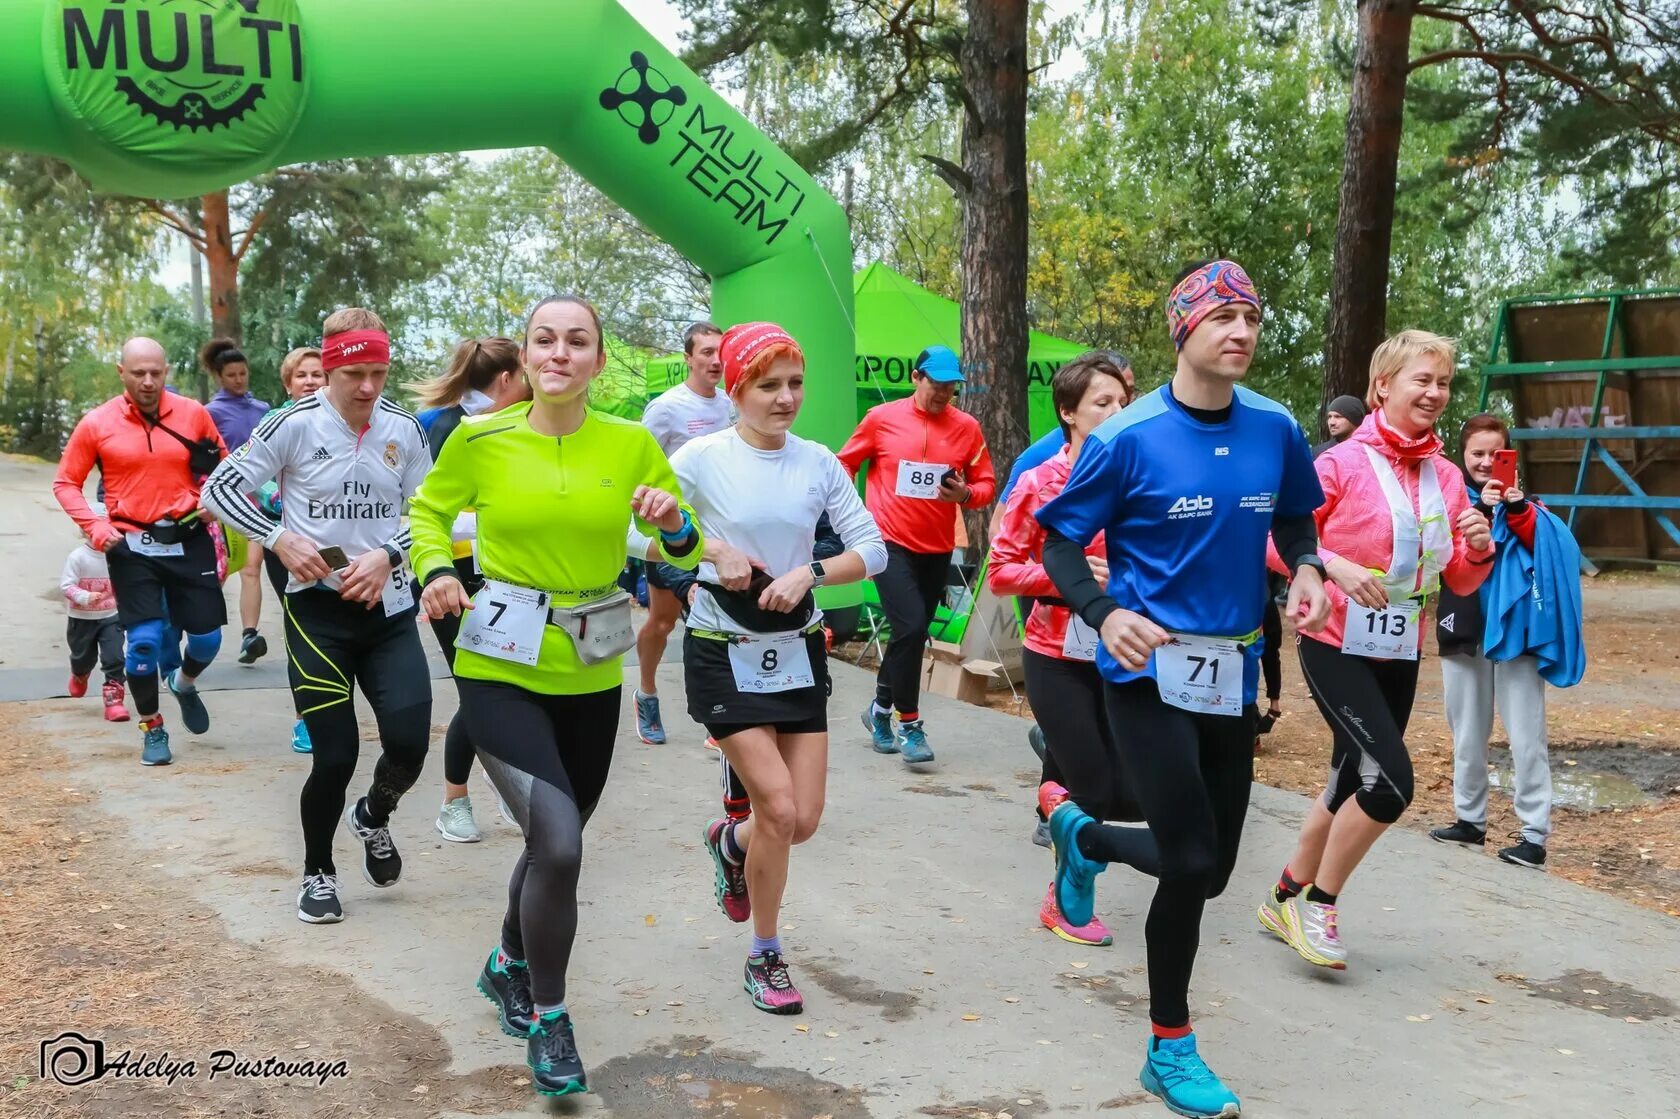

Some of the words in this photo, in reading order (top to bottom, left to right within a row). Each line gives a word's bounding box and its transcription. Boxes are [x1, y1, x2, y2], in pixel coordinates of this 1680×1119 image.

[63, 8, 303, 82] MULTI
[210, 79, 243, 103] SERVICE
[685, 103, 805, 216] MULTI
[669, 130, 789, 245] TEAM
[343, 481, 371, 498] Fly
[911, 471, 935, 486] 88
[1178, 511, 1196, 519] БАРС
[488, 600, 507, 627] 7
[1366, 611, 1406, 636] 113
[761, 649, 777, 671] 8
[1187, 655, 1219, 684] 71
[1340, 705, 1375, 743] Salomon
